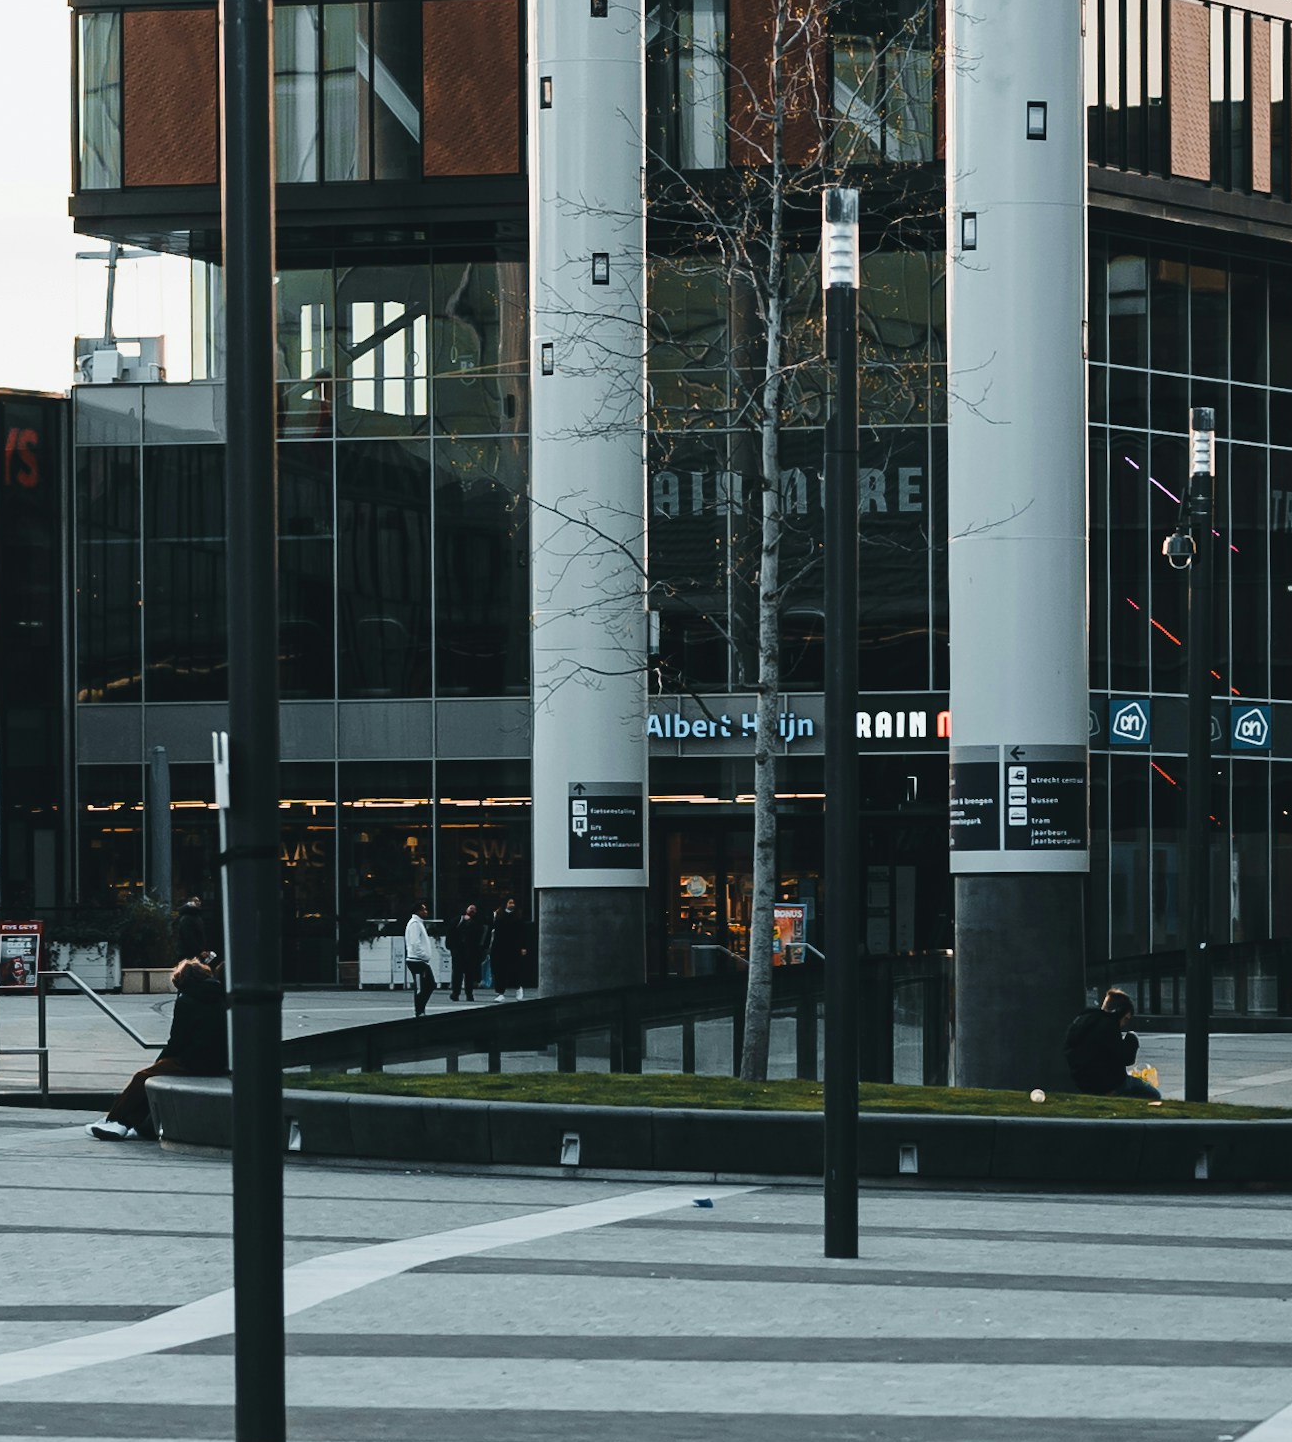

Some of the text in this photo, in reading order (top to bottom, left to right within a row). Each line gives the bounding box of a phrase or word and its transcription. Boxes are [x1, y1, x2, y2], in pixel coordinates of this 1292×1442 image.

[646, 713, 815, 743] Albert Hijn
[1030, 796, 1059, 804] bussen
